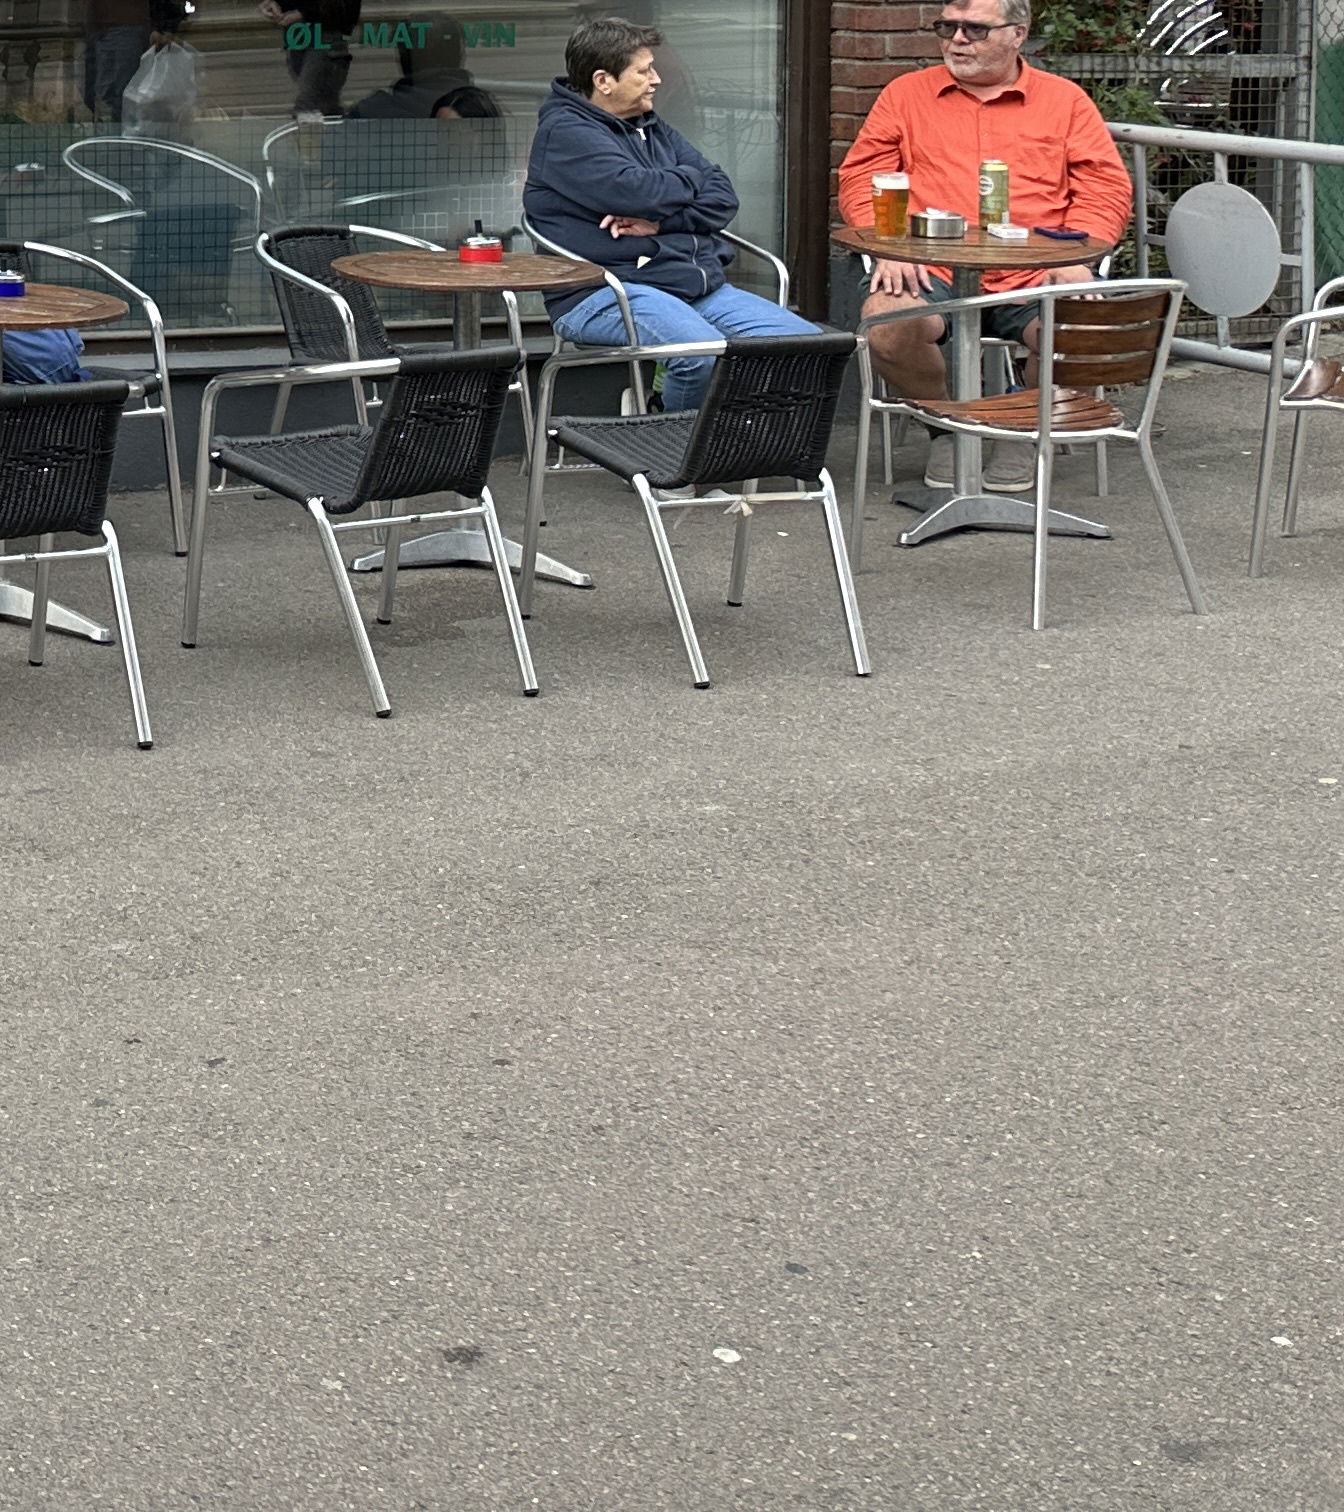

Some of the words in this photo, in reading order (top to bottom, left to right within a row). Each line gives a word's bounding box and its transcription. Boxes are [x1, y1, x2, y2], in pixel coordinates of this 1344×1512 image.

[286, 22, 332, 50] ØL
[362, 22, 432, 49] MAT
[464, 22, 517, 49] VIN
